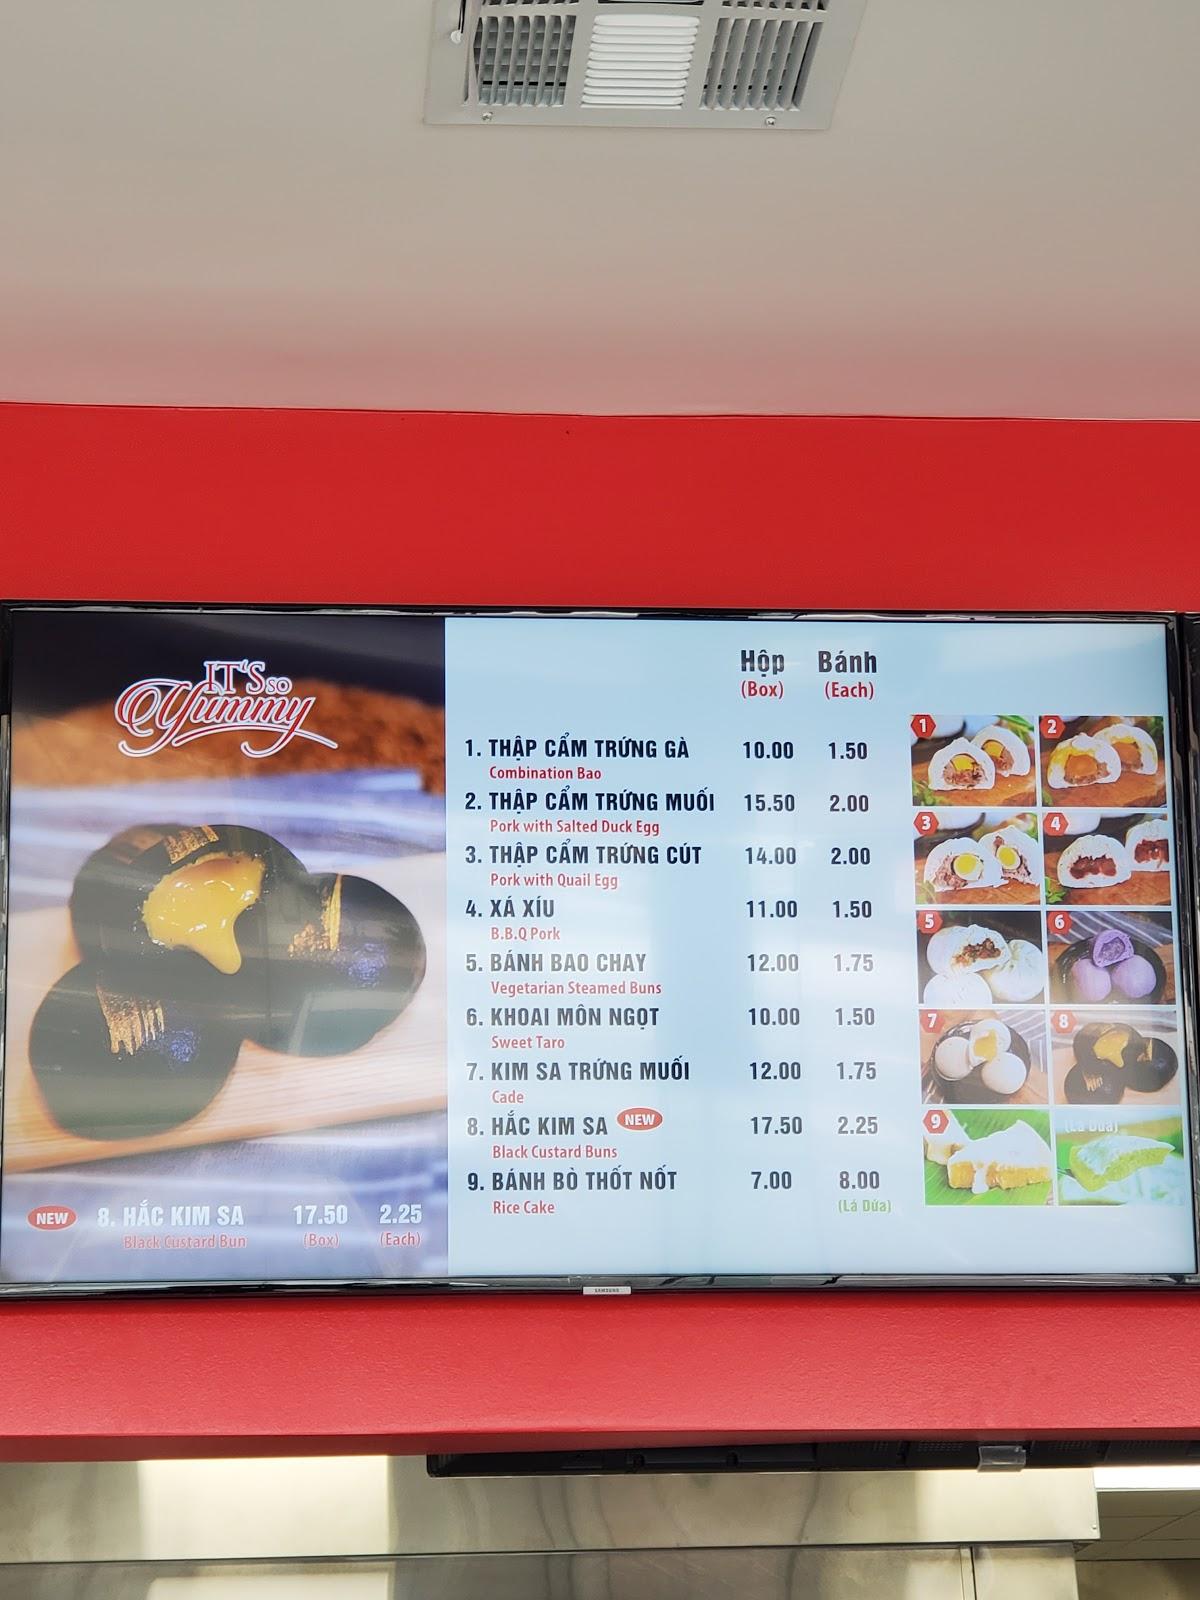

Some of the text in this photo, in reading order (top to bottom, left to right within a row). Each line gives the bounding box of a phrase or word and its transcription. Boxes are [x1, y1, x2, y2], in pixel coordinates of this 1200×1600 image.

[741, 650, 784, 677] Hộp
[818, 650, 877, 674] Bánh
[204, 659, 265, 695] IT'S
[741, 680, 784, 699] (Box)
[824, 681, 874, 700] (Each)
[114, 678, 316, 758] Yummy
[919, 719, 927, 732] 1
[1047, 720, 1057, 733] 2
[465, 732, 689, 761] 1. THẬP CẨM TRỨNG GÀ
[743, 741, 794, 759] 10.00
[828, 742, 868, 760] 1.50
[489, 766, 602, 780] Combination Bao
[465, 785, 715, 814] 2. THẬP CẨM TRỨNG MUỐI
[744, 794, 795, 812] 15.50
[829, 795, 869, 812] 2.00
[490, 820, 660, 837] Pork with Salted Duck Egg
[921, 816, 931, 830] 3
[1050, 817, 1061, 831] 4
[465, 838, 702, 868] 3. THẬP CẨM TRỨNG CÚT
[745, 847, 797, 865] 14.00
[831, 848, 871, 865] 2.00
[491, 873, 618, 890] Pork with Quail Egg
[465, 896, 555, 918] 4. XÁ XÍU
[746, 901, 798, 918] 11.00
[832, 901, 872, 918] 1.50
[925, 915, 934, 928] 5
[1055, 915, 1064, 929] 6
[491, 927, 560, 941] B.B.Q Pork
[466, 950, 646, 972] 5. BÁNH BAO CHAY
[747, 954, 799, 972] 12.00
[834, 954, 874, 972] 1.75
[491, 981, 662, 998] Vegetarian Steamed Buns
[466, 1004, 659, 1030] 6. KHOAI MÔN NGỌT
[748, 1008, 800, 1026] 10.00
[835, 1008, 875, 1026] 1.50
[928, 1014, 937, 1027] 7
[1059, 1014, 1069, 1028] 8
[491, 1036, 565, 1048] Sweet Taro
[466, 1055, 689, 1081] 7. KIM SA TRỨNG MUỐI
[750, 1062, 801, 1080] 12.00
[836, 1062, 877, 1080] 1.75
[492, 1090, 524, 1104] Cade
[467, 1110, 608, 1136] 8. HẮC KIM SA
[624, 1114, 655, 1126] NEW
[751, 1116, 803, 1135] 17.50
[837, 1116, 878, 1135] 2.25
[931, 1114, 941, 1128] 9
[492, 1145, 617, 1158] Black Custard Buns
[467, 1165, 677, 1191] 9. BÁNH BÒ THỐT NỐT
[751, 1171, 792, 1190] 7.00
[839, 1171, 880, 1190] 8.00
[97, 1200, 244, 1227] 8. HẮC KIM SA
[293, 1205, 348, 1224] 17.50
[379, 1204, 422, 1224] 2.25
[493, 1201, 555, 1214] Rice Cake
[36, 1213, 69, 1225] NEW
[124, 1235, 246, 1249] Black Custard Bun
[303, 1233, 340, 1248] (Box)
[380, 1232, 421, 1247] (Each)
